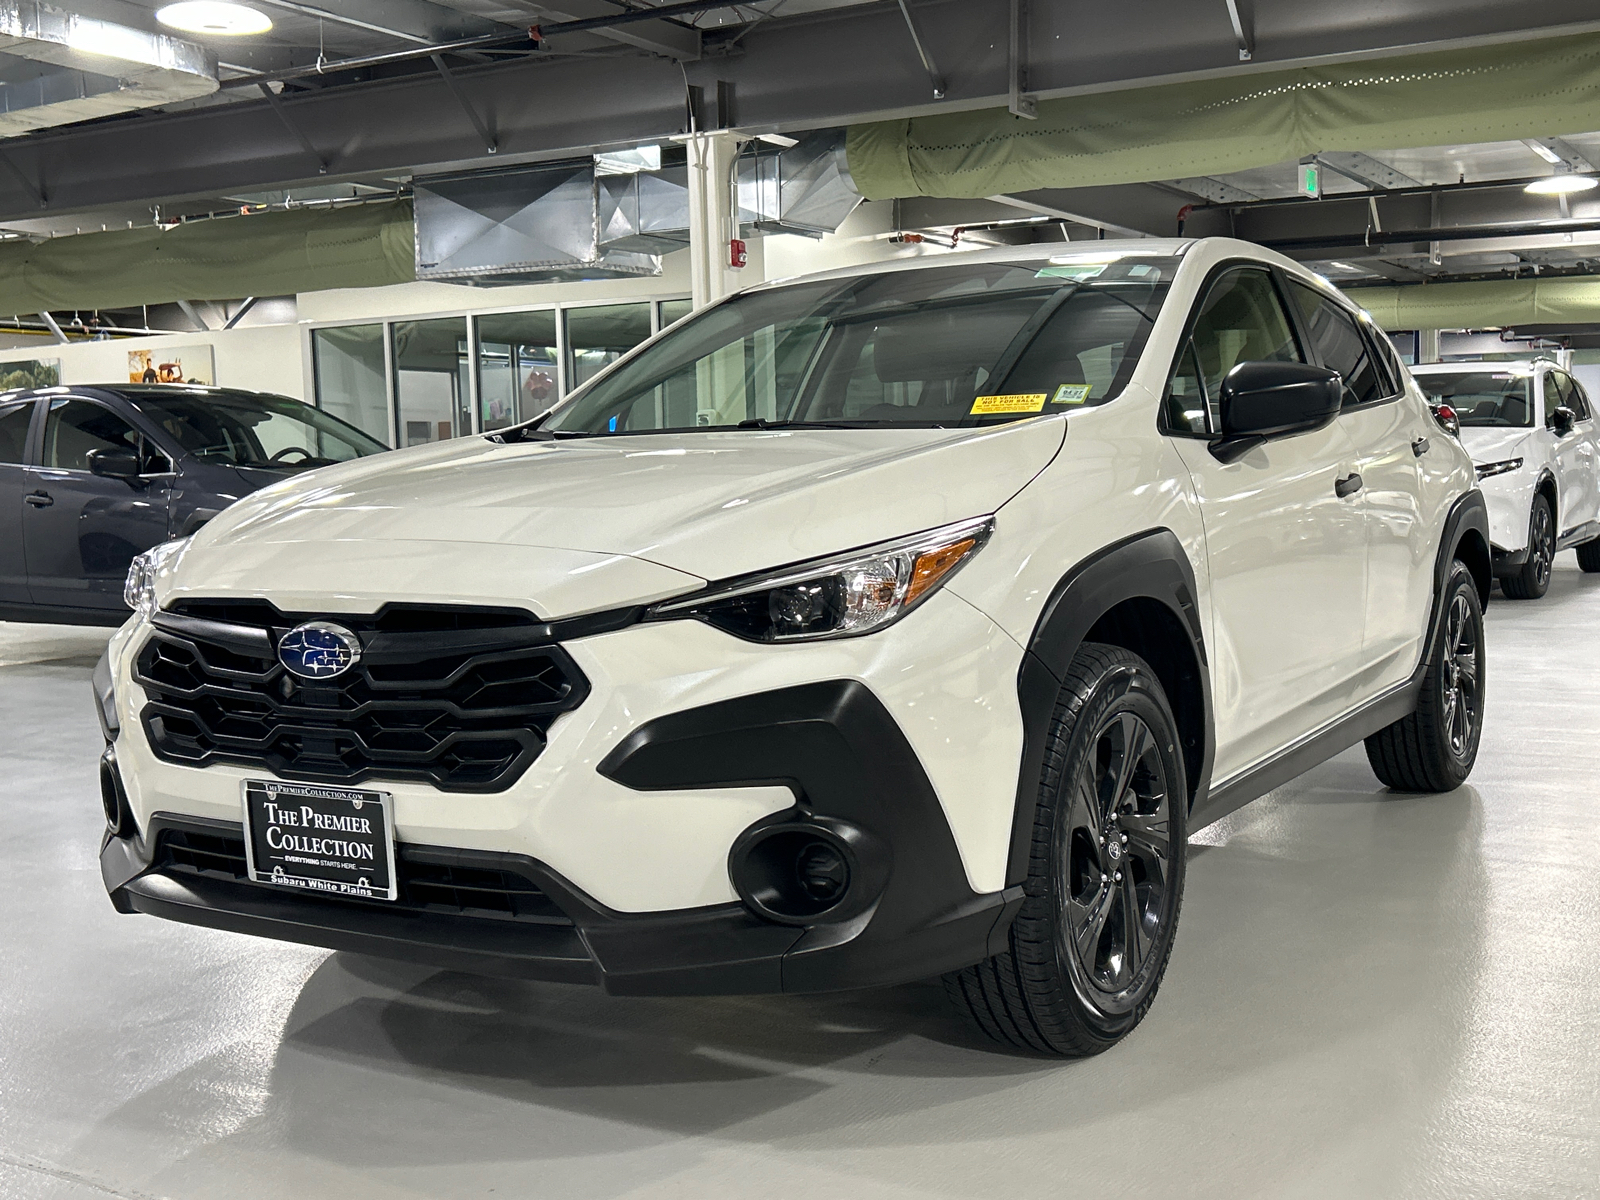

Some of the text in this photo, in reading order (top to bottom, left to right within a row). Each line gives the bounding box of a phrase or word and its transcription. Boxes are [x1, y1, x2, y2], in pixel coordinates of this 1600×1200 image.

[264, 802, 372, 834] THE PREMIER
[266, 826, 374, 860] COLLECTION
[284, 855, 320, 865] EVERYTHING
[320, 859, 341, 869] STARTS
[270, 875, 372, 896] Subaru White Plains
